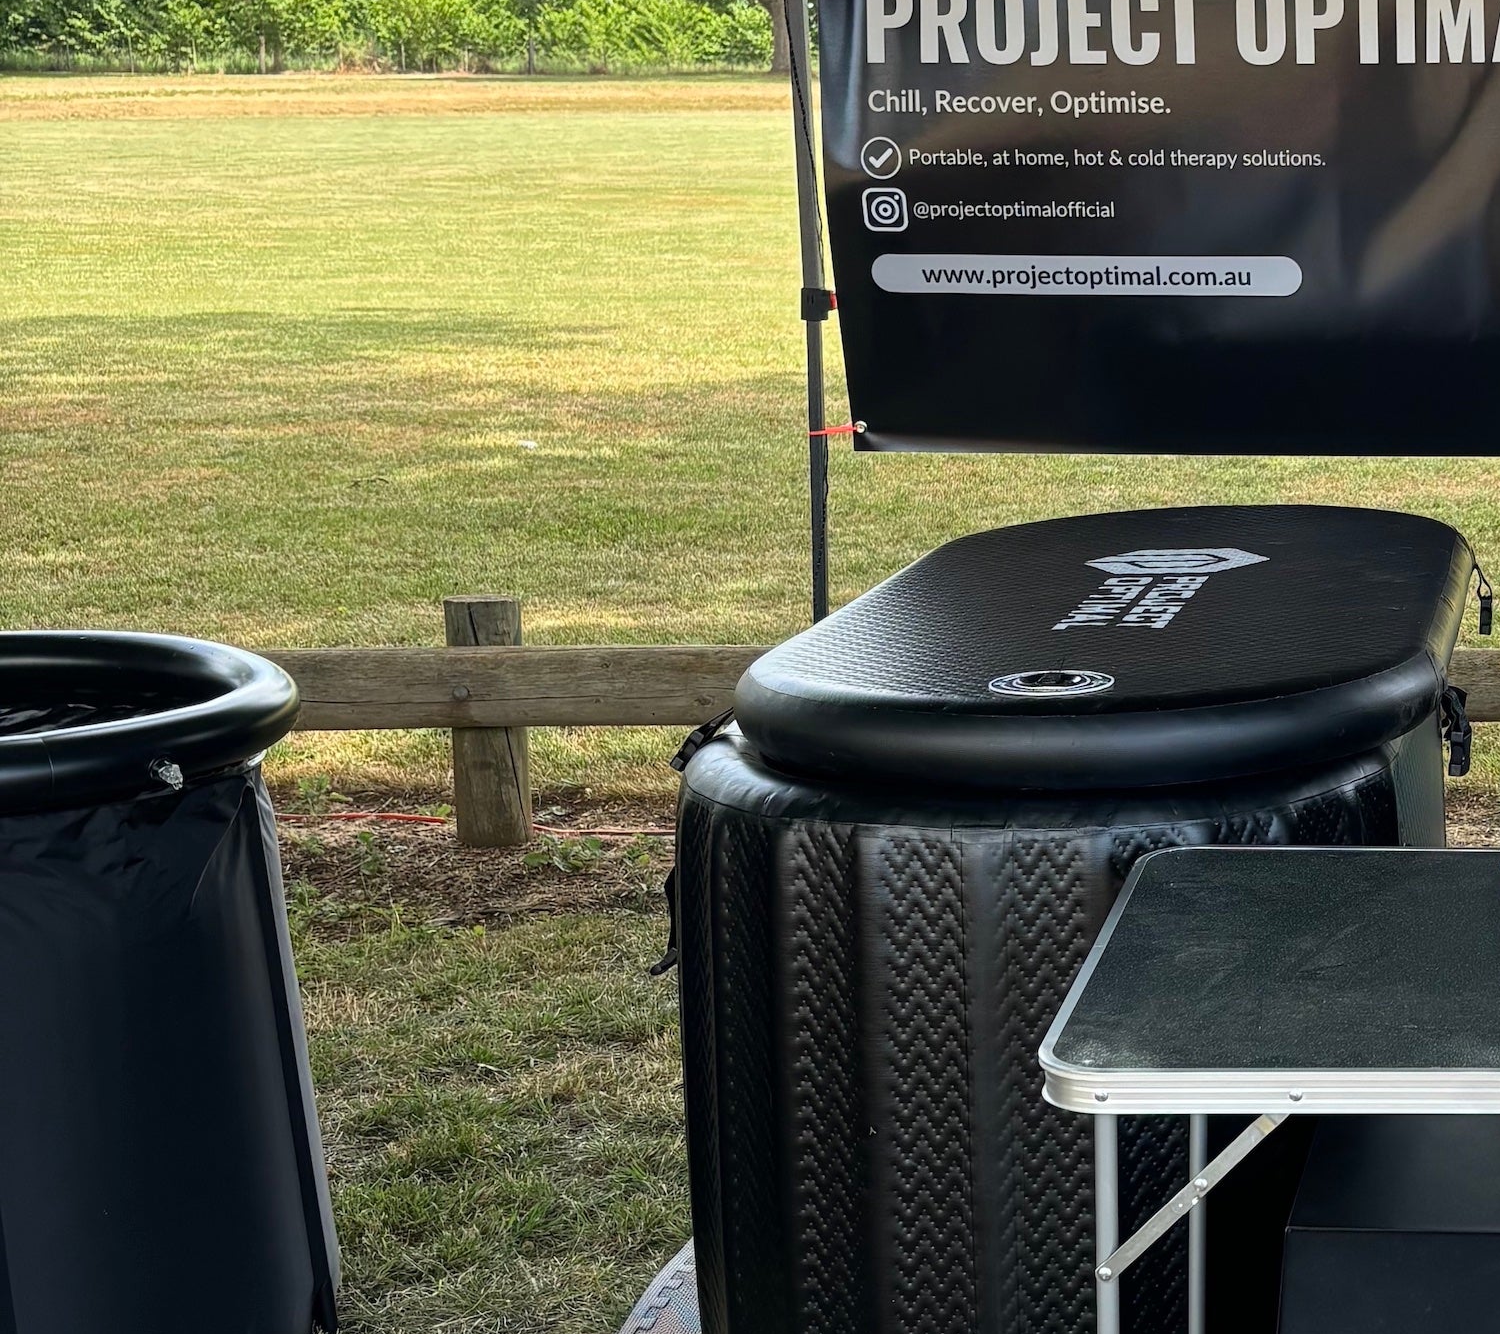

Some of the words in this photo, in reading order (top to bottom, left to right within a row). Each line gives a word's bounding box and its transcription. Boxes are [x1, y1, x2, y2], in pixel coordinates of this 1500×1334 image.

[867, 88, 928, 116] Chill,
[935, 89, 1043, 116] Recover,
[1050, 90, 1171, 118] Optimise.
[908, 148, 988, 167] Portable,
[992, 150, 1011, 166] at
[1015, 149, 1069, 168] home,
[1074, 149, 1105, 166] hot
[1109, 149, 1123, 166] &
[1128, 149, 1165, 166] cold
[1170, 149, 1238, 169] therapy
[1242, 149, 1327, 167] solutions.
[913, 201, 1115, 220] @projectoptimalofficial
[922, 263, 1252, 290] www.projectoptimal.com.au
[1051, 576, 1153, 630] OPTIMAL
[1115, 575, 1210, 629] PROJECT
